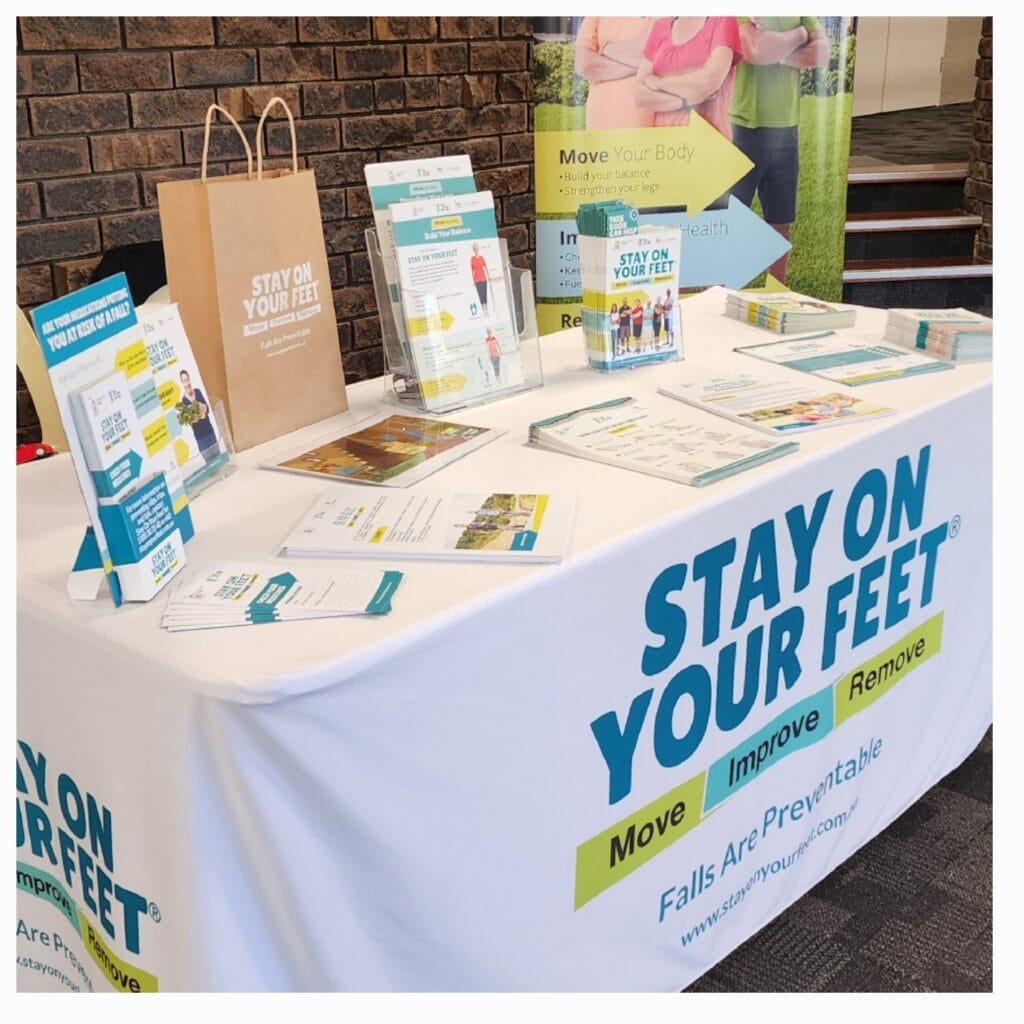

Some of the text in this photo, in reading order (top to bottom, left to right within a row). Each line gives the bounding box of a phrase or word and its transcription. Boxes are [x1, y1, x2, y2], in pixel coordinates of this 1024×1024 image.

[560, 143, 695, 165] Move Your Body
[564, 168, 651, 183] Build your balance
[564, 182, 660, 197] Strengthen your legs
[424, 227, 472, 241] Build Your Balance
[680, 220, 729, 237] Health
[613, 260, 674, 279] YOUR FEET
[620, 248, 669, 265] STAY ON
[252, 261, 312, 296] STAY ON
[242, 279, 320, 320] YOUR FEET
[46, 330, 67, 352] YOU
[67, 328, 78, 344] AT
[77, 320, 94, 339] RISK
[94, 315, 106, 333] OF
[641, 444, 931, 676] STAY ON
[590, 606, 805, 806] YOUR
[609, 636, 926, 869] Move Improve Remove
[57, 773, 114, 874] ON
[659, 737, 883, 923] Falls Are Preventable
[16, 919, 50, 946] Are
[87, 926, 142, 993] Remove
